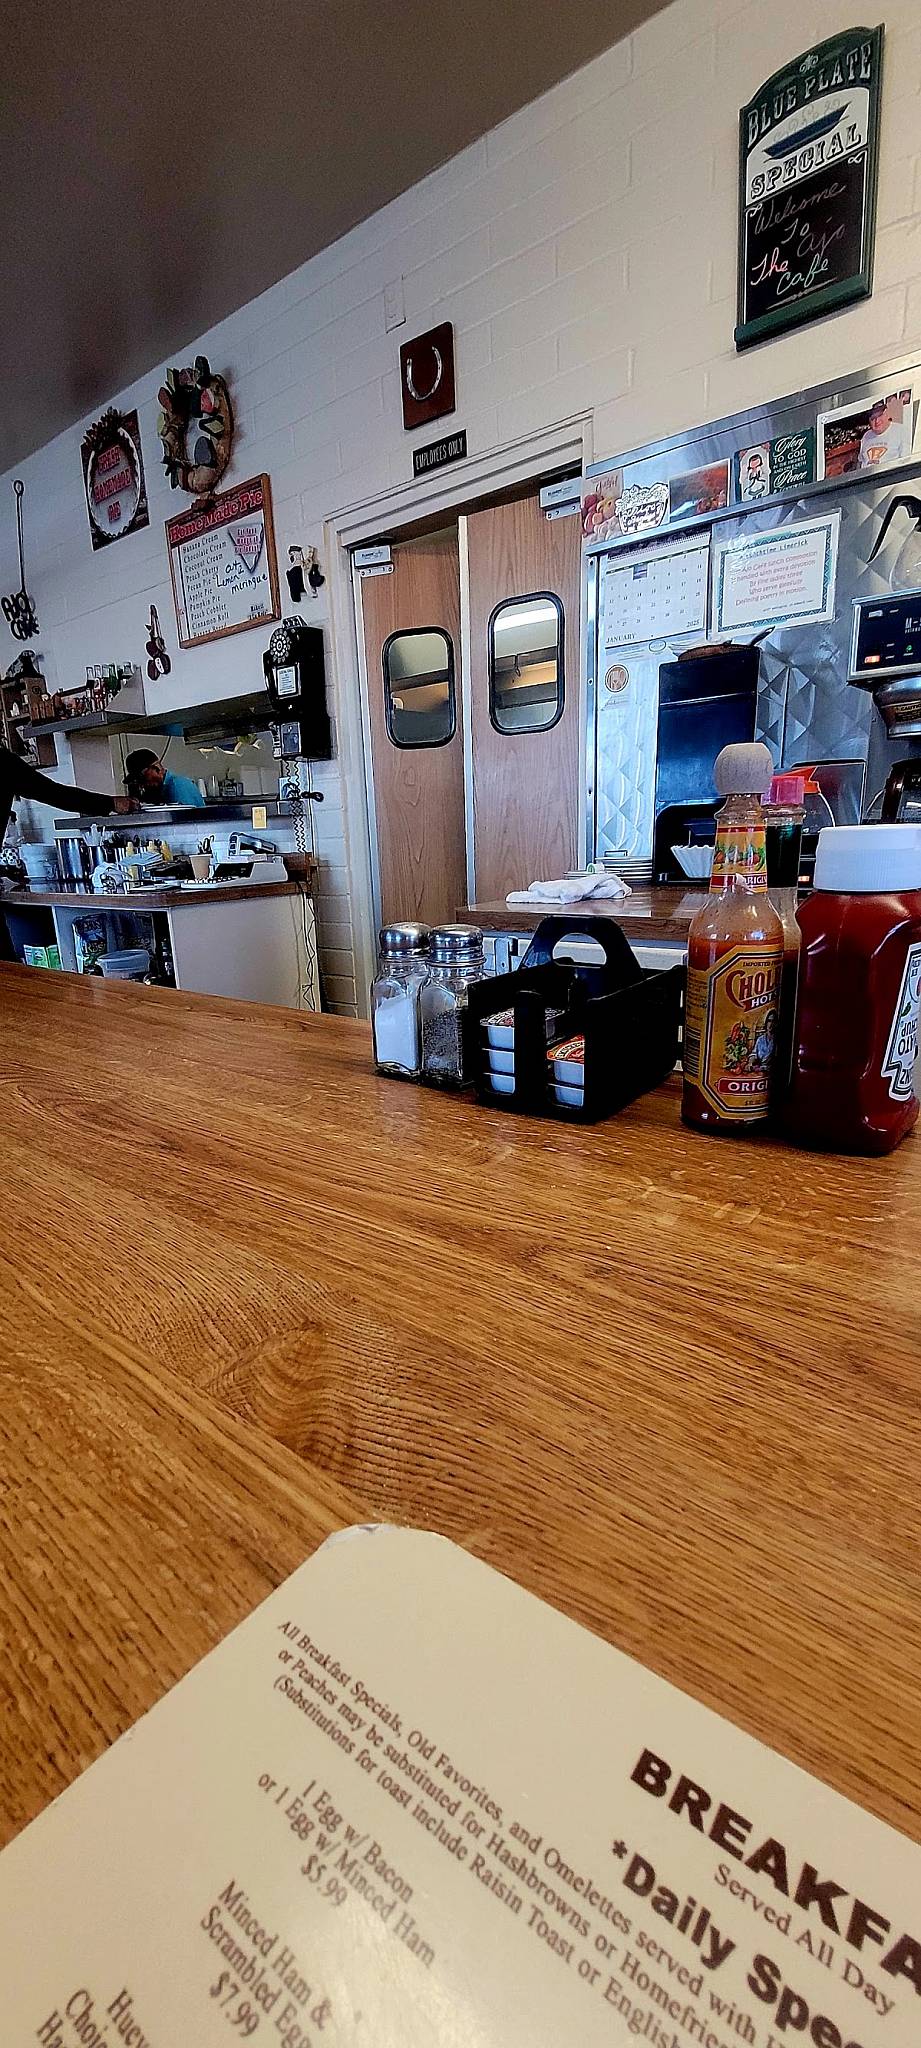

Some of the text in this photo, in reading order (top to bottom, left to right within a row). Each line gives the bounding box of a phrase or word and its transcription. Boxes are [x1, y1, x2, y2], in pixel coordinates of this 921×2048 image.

[748, 41, 872, 149] BLUE PLATE
[750, 122, 861, 199] SPECIAL
[754, 182, 846, 235] Welcome
[750, 247, 789, 286] The
[415, 437, 464, 470] EMPLOYEES ONLY
[773, 435, 807, 458] Glory
[773, 448, 807, 464] TO GOD
[239, 490, 263, 511] Pie
[183, 547, 209, 564] Chocolate
[209, 541, 227, 556] Cream
[184, 553, 223, 574] Coconut Cream
[201, 533, 219, 548] Cream
[231, 573, 268, 595] meringue
[606, 633, 635, 643] JANUARY
[725, 969, 782, 1008] CHOL
[751, 994, 773, 1008] HOT
[273, 1673, 353, 1754] (Substitutions
[354, 1749, 378, 1775] for
[376, 1770, 413, 1809] toast
[412, 1800, 469, 1861] include
[469, 1853, 524, 1915] Raisin
[526, 1904, 575, 1965] Toast
[577, 1957, 601, 1986] or
[277, 1621, 757, 2046] All Breakfast Specials, Old Favorites, and Omelettes served with
[277, 1649, 730, 2048] or Peaches may be substituted for Hashbrowns or Homefrie
[303, 1780, 414, 1904] 1 Egg w/ Bacon
[258, 1773, 436, 1969] or 1 Egg w/ Minced Ham
[301, 1854, 348, 1907] $5.99
[201, 1905, 282, 2015] Scrambled
[218, 1878, 332, 2031] Minced Ham &
[714, 1863, 895, 2017] Served All Day
[209, 1971, 260, 2038] $7.99
[747, 1954, 864, 2048] Spe
